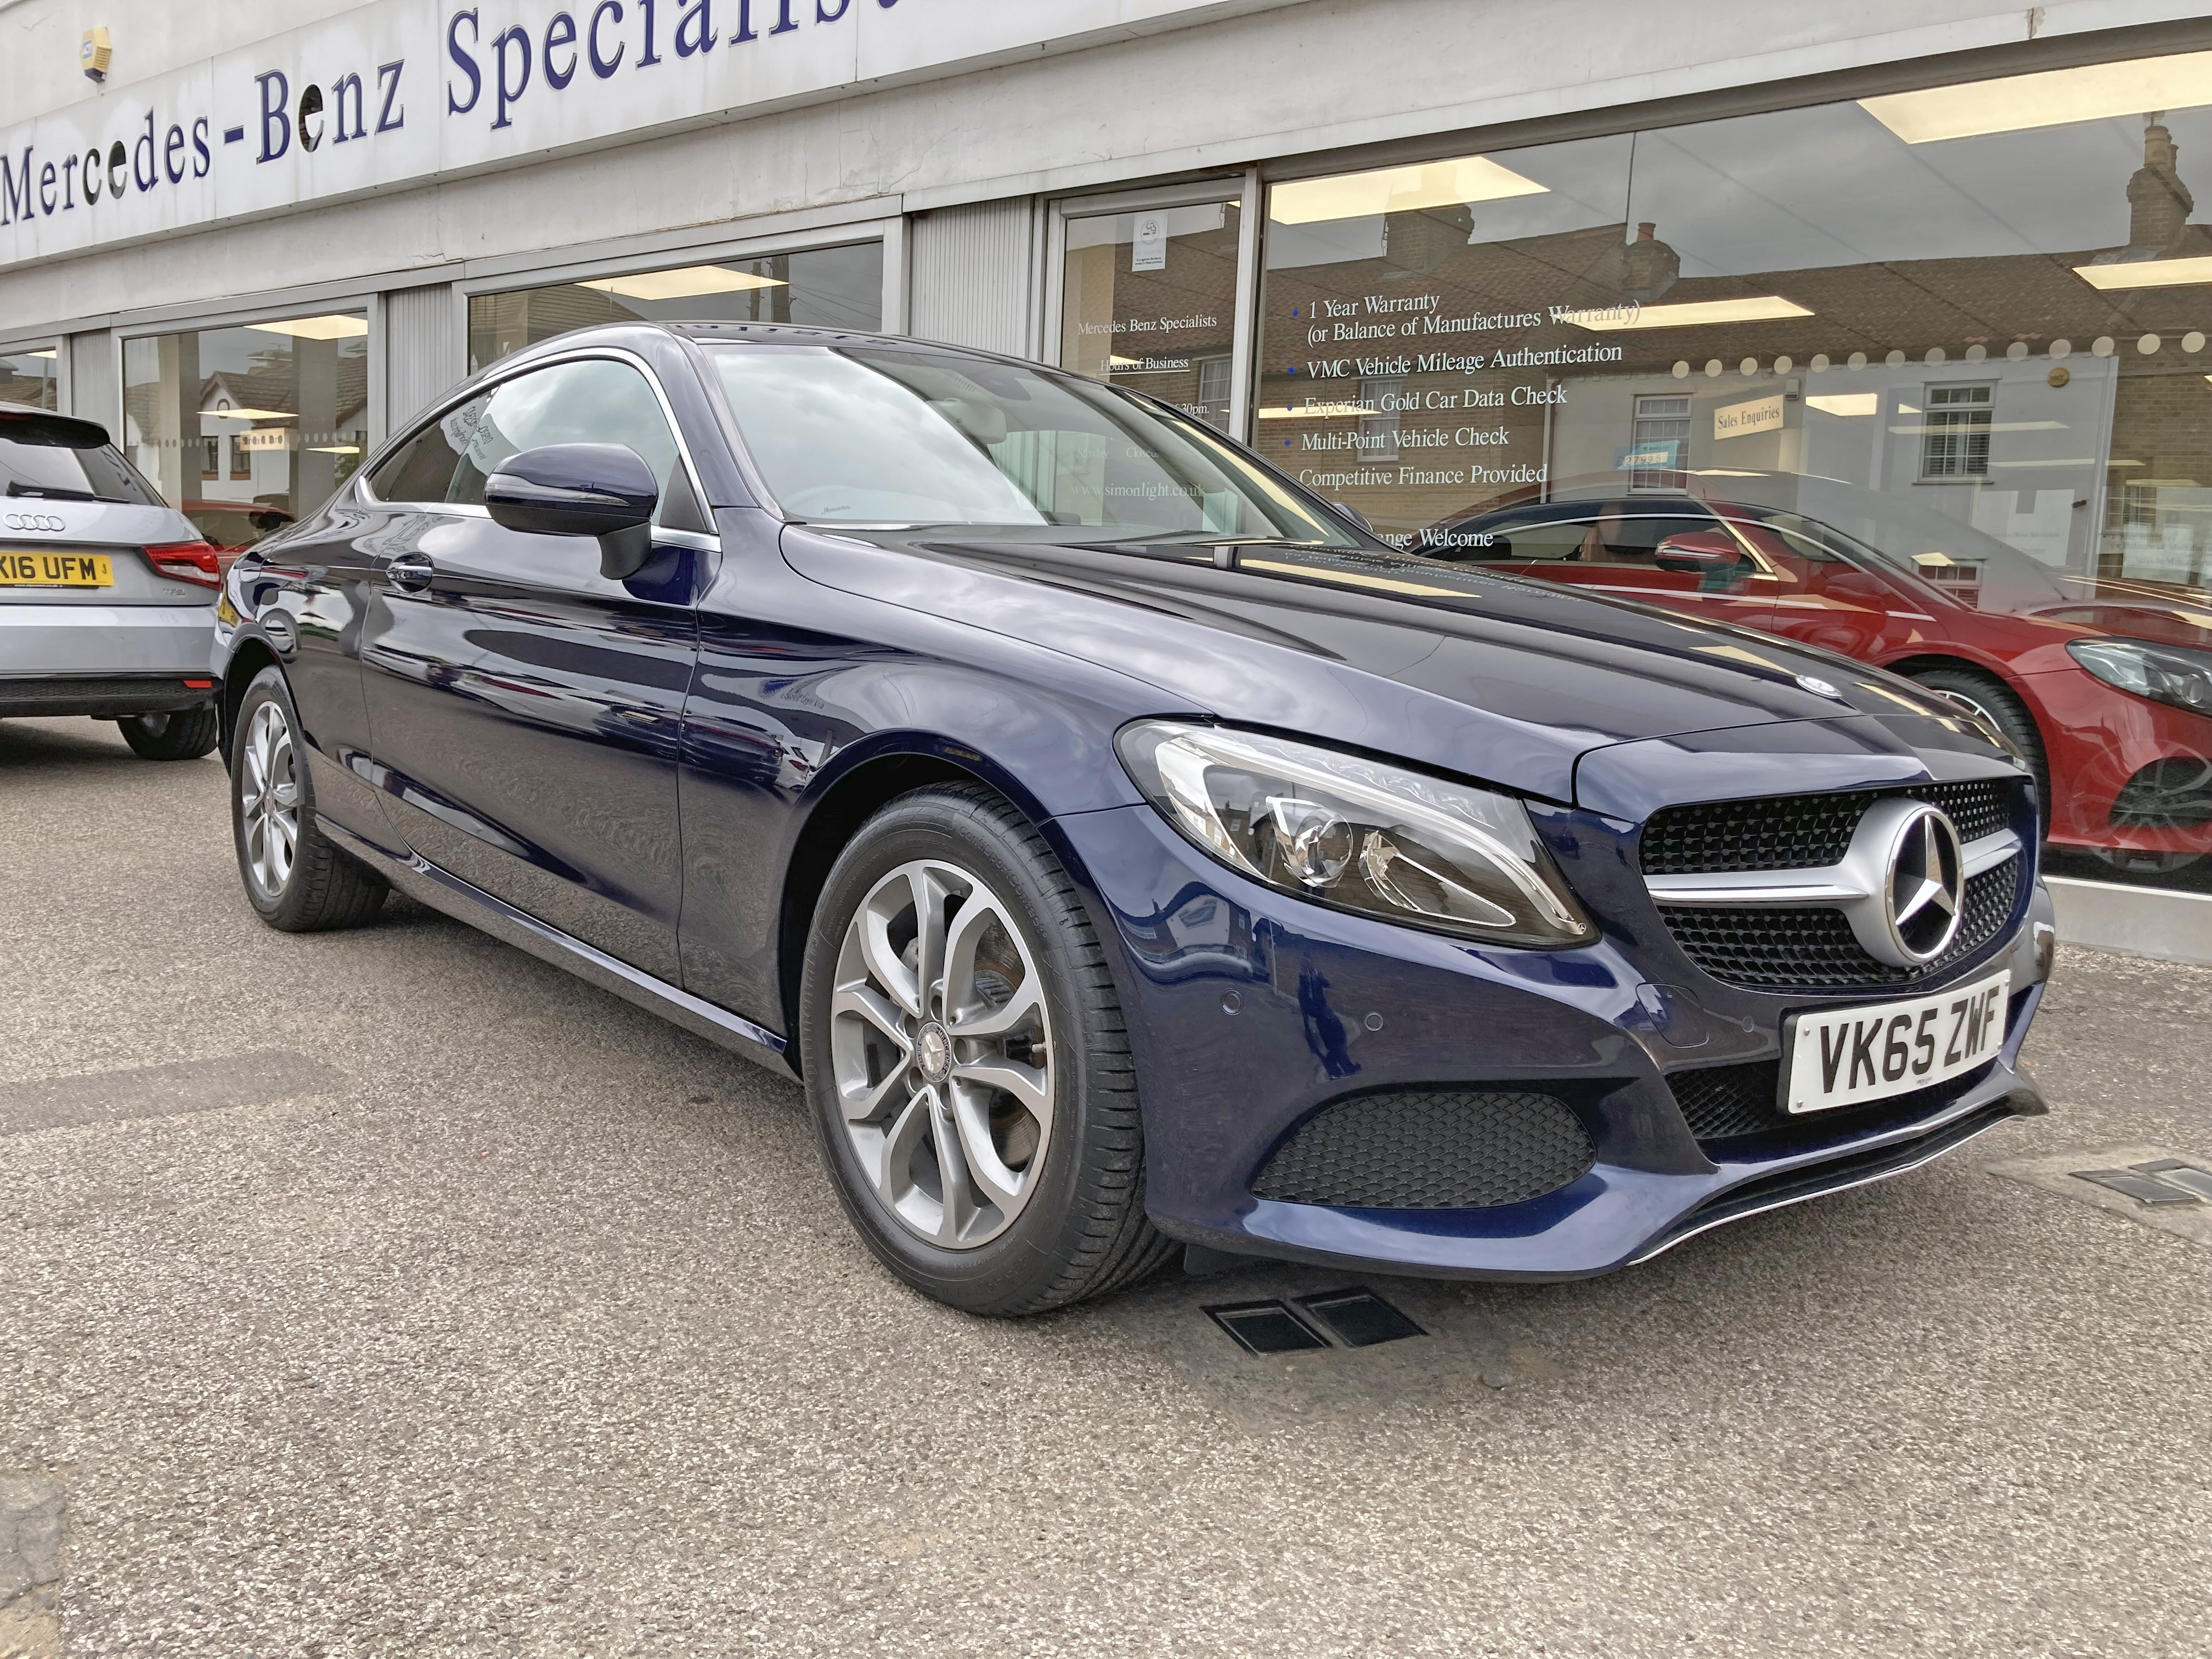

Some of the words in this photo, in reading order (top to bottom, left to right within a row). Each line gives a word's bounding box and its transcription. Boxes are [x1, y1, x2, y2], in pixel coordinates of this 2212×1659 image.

[0, 59, 405, 227] Mercedes-Benz
[446, 0, 901, 132] Specia
[1310, 302, 1316, 319] 1
[1323, 299, 1358, 319] Year
[1364, 294, 1440, 314] Warranty
[1077, 320, 1126, 335] Mercedes
[1129, 318, 1156, 332] Benz
[1160, 314, 1217, 334] Specialists
[1307, 325, 1328, 348] (or
[1333, 321, 1395, 342] Balance
[1401, 317, 1419, 336] of
[1423, 310, 1541, 335] Manufactures
[1548, 300, 1641, 326] Warranty)
[1100, 359, 1129, 372] Hours
[1132, 358, 1144, 370] of
[1145, 357, 1189, 370] Business
[1307, 359, 1350, 379] VMC
[1355, 355, 1412, 376] Vehicle
[1417, 351, 1485, 374] Mileage
[1490, 342, 1622, 369] Authentication
[1304, 394, 1375, 419] Experian
[1380, 391, 1420, 411] Gold
[1425, 390, 1458, 409] Car
[1463, 388, 1504, 408] Data
[1511, 384, 1567, 406] Check
[1718, 414, 1738, 430] Sales
[1741, 405, 1780, 426] Enquiries
[1301, 431, 1385, 451] Multi-Point
[1392, 428, 1449, 448] Vehicle
[1454, 426, 1509, 446] Check
[1077, 448, 1108, 460] Sunday
[1299, 468, 1392, 491] Competitive
[1397, 465, 1464, 486] Finance
[1470, 462, 1548, 484] Provided
[1419, 528, 1493, 547] Welcome
[43, 557, 97, 580] UFM
[1820, 1007, 1938, 1094] VK65
[1944, 985, 2000, 1068] ZWF
